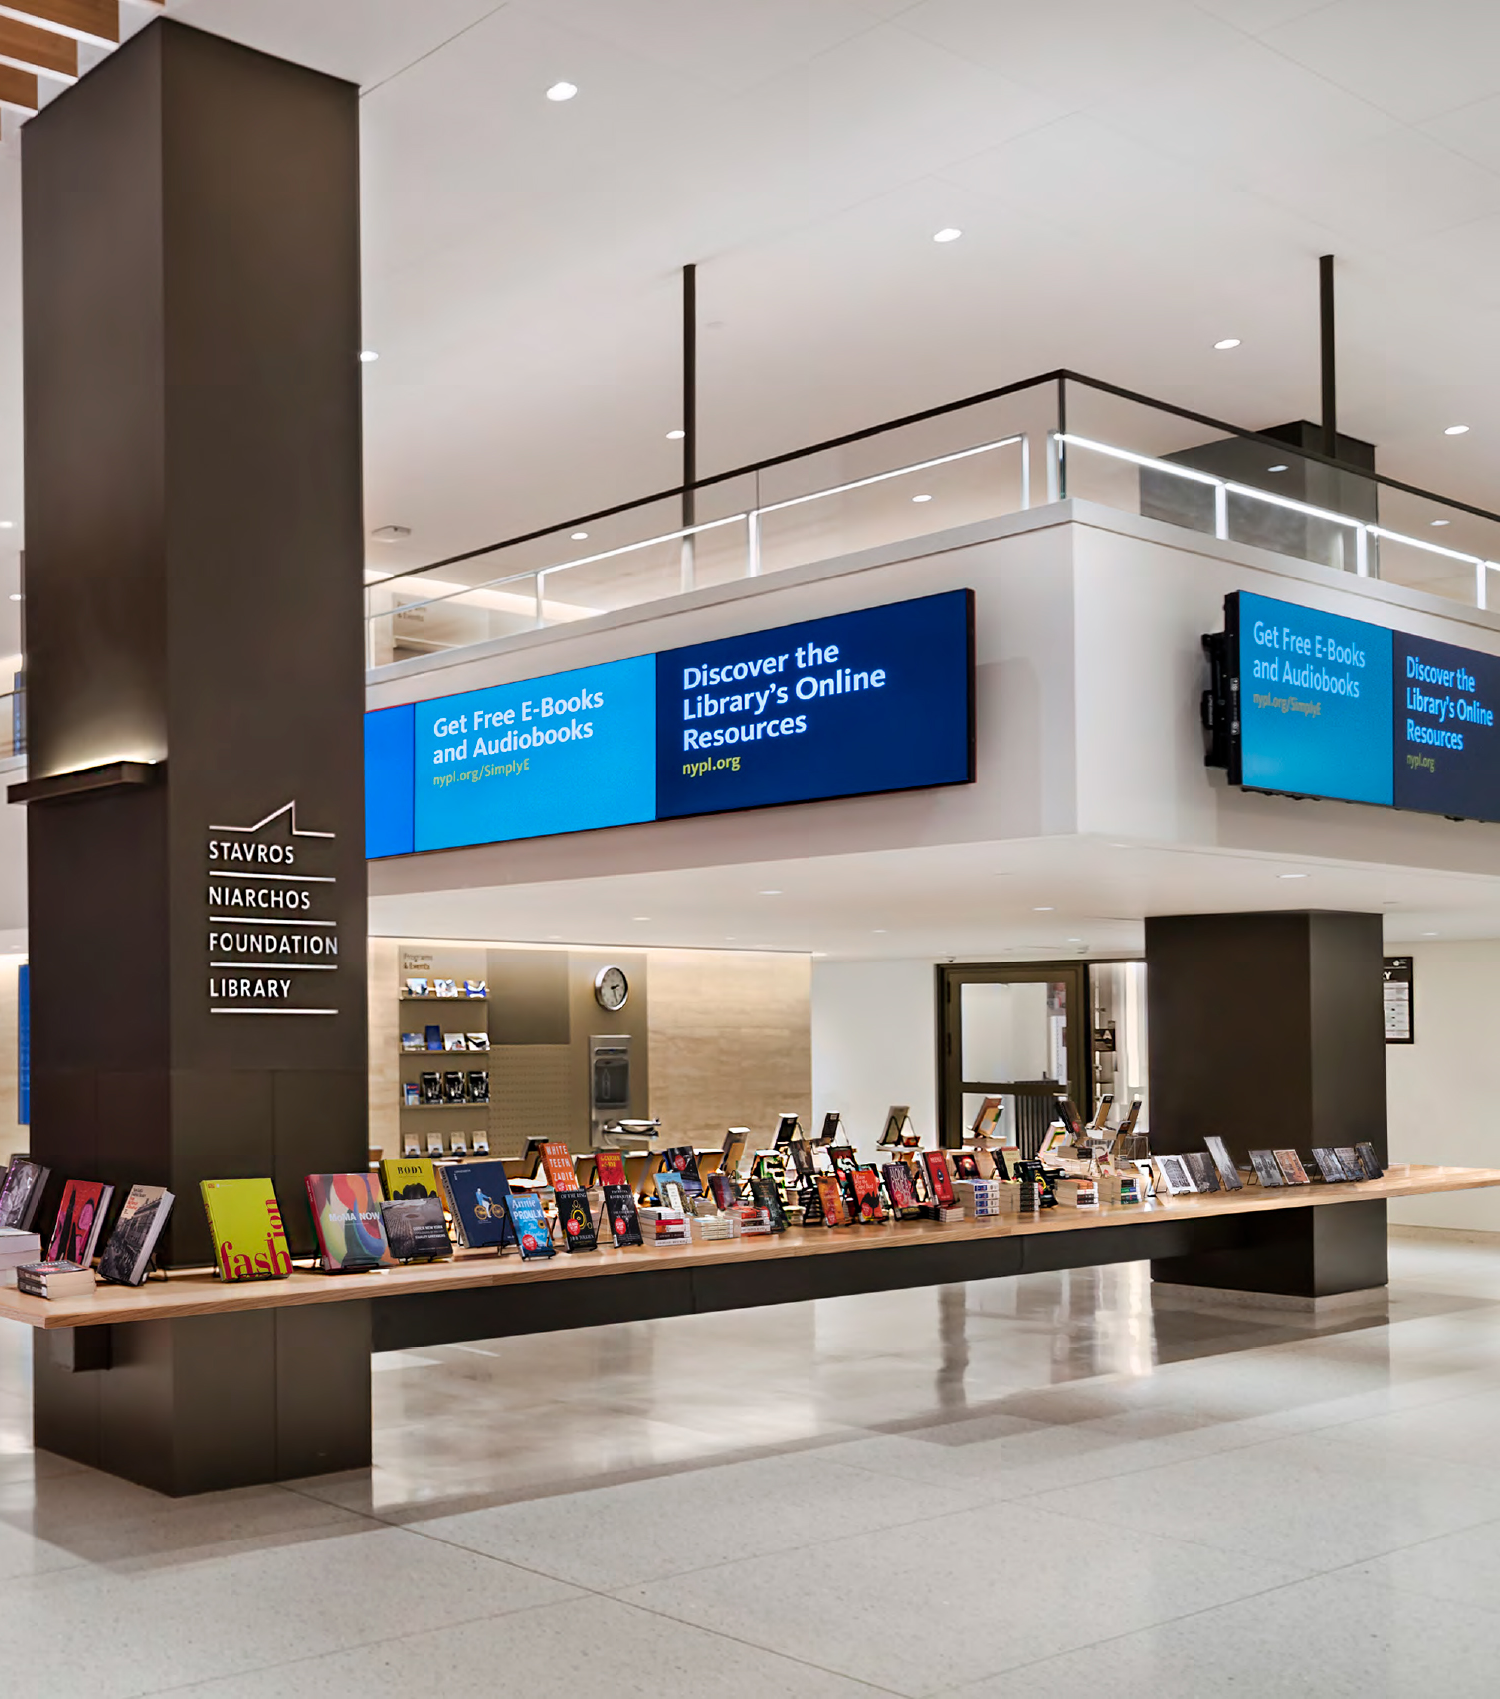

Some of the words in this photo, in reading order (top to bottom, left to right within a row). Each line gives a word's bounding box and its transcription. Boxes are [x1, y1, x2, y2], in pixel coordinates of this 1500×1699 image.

[1254, 621, 1279, 649] Get
[1283, 628, 1311, 656] Free
[1315, 636, 1365, 668] E-Books
[684, 653, 789, 690] Discover
[795, 642, 839, 668] the
[1407, 656, 1454, 688] Discover
[1456, 668, 1476, 692] the
[1254, 658, 1278, 682] and
[1282, 661, 1360, 698] Audiobooks
[683, 683, 789, 720] Library's
[796, 668, 886, 700] Online
[433, 715, 467, 737] Get
[474, 709, 515, 731] Free
[522, 688, 604, 721] E-Books
[1407, 687, 1455, 723] Library's
[1457, 699, 1493, 726] Online
[433, 739, 467, 764] and
[473, 718, 593, 757] Audiobooks
[683, 715, 807, 751] Resources
[1407, 719, 1464, 750] Resources
[433, 758, 530, 788] nypl.org/SimplyE
[682, 756, 741, 777] nypl.org
[1406, 753, 1435, 773] nypl.org
[208, 841, 294, 864] STAVROS
[208, 886, 311, 909] NIARCHOS
[209, 933, 338, 955] FOUNDATION
[209, 978, 291, 998] LIBRARY
[545, 1145, 568, 1155] WHITE
[397, 1166, 424, 1175] BODY
[549, 1158, 571, 1167] TEETH
[553, 1171, 574, 1181] ZADIE
[512, 1199, 536, 1208] Annie
[513, 1210, 543, 1220] PROULX
[329, 1212, 357, 1222] MoMA
[359, 1211, 380, 1221] NOW
